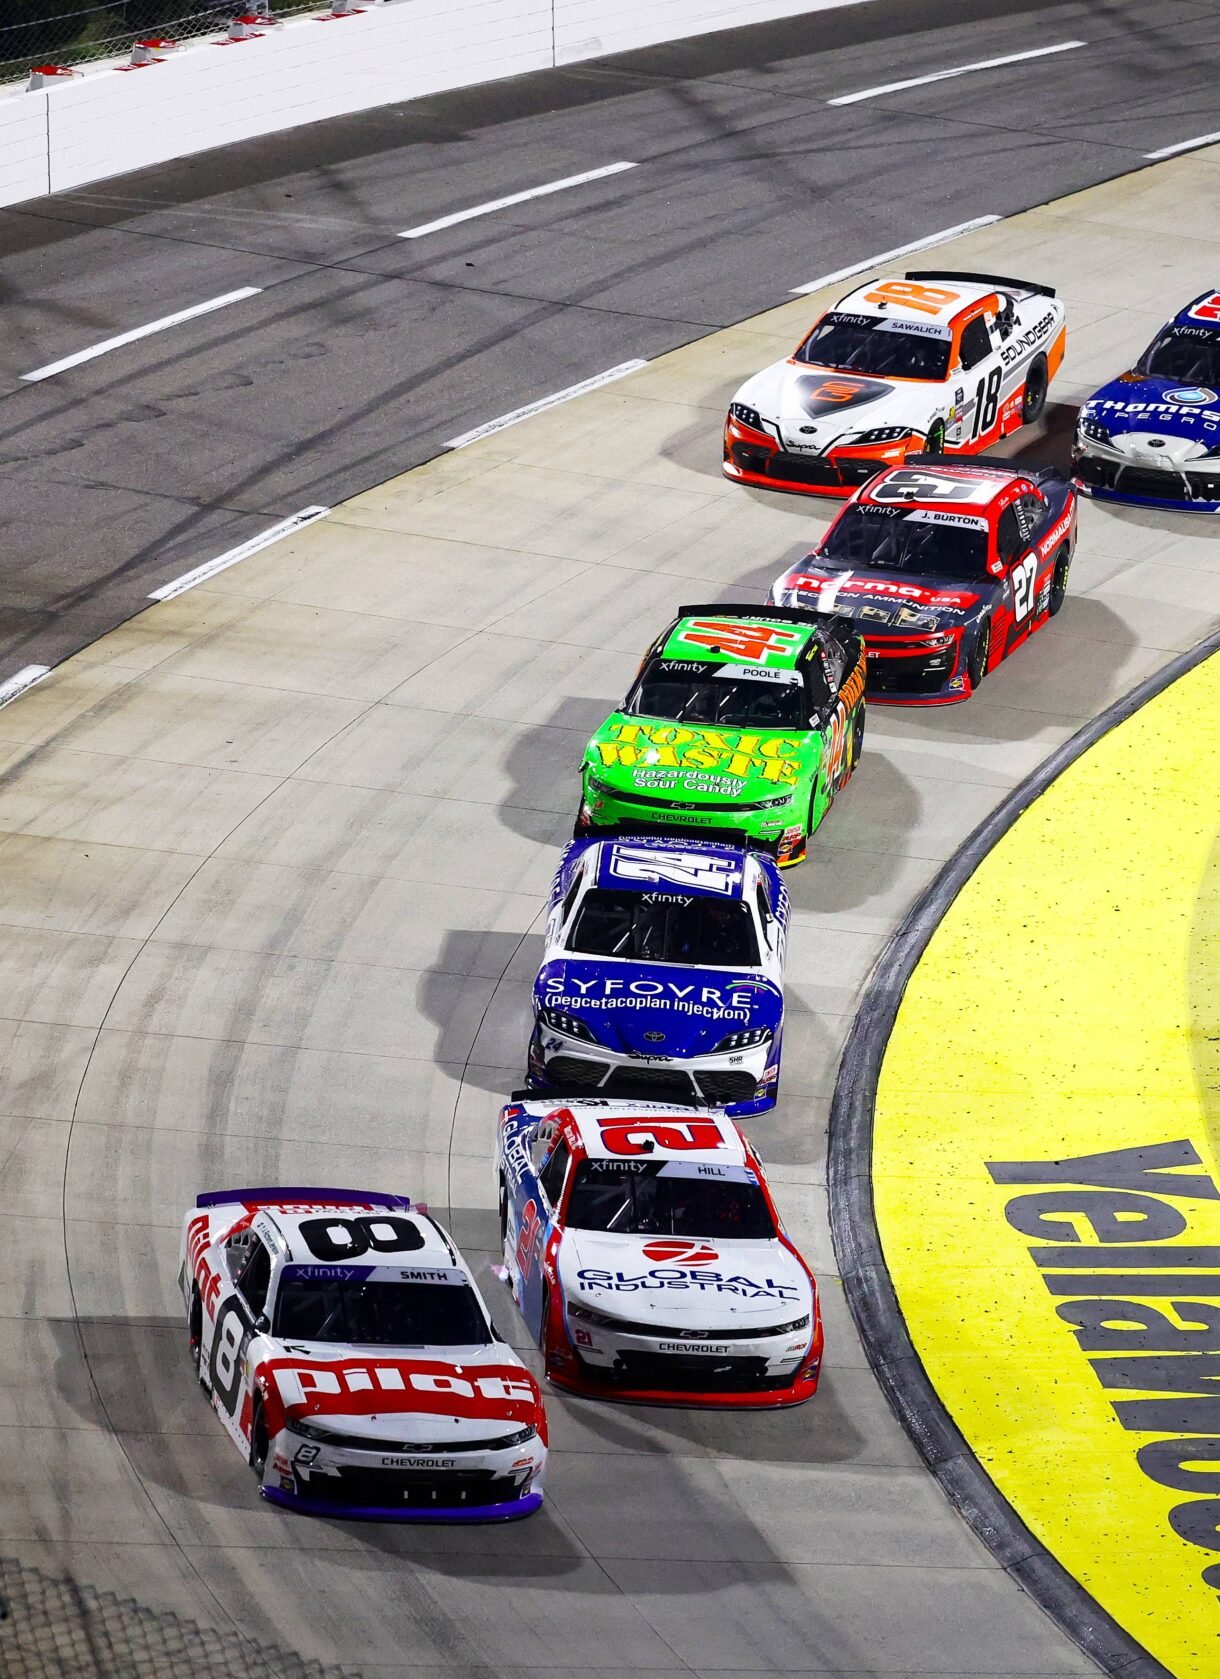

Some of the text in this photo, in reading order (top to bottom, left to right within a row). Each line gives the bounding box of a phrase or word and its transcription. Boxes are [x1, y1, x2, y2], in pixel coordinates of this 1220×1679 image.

[864, 282, 961, 315] 18
[830, 314, 871, 326] xfinity
[891, 322, 942, 335] SAWALICH
[1171, 326, 1212, 339] xfinity
[1000, 312, 1055, 366] SOUNDGEAR
[972, 366, 1002, 440] 18
[785, 439, 822, 451] Supra
[856, 504, 900, 517] xfinity
[934, 513, 979, 526] BURTON
[1012, 552, 1038, 622] 27
[862, 594, 966, 615] AMMUNITION
[930, 596, 961, 604] USA
[660, 661, 707, 673] xfinity
[743, 668, 781, 679] POOLE
[609, 724, 801, 758] TOXIC
[597, 743, 802, 786] WASTE
[632, 769, 747, 788] Hazardously
[634, 778, 741, 798] Sour Candy
[652, 812, 713, 825] CHEVROLET
[641, 892, 694, 906] xfinity
[546, 978, 751, 1008] SYFOVRE
[545, 994, 751, 1021] (pegcetacoplan injection)
[545, 1037, 563, 1051] 24
[627, 1052, 674, 1064] Supra
[503, 1120, 531, 1185] GLOBAL
[591, 1160, 648, 1173] xfinity
[698, 1166, 726, 1176] HILL
[298, 1216, 426, 1262] 8
[296, 1268, 354, 1280] xfinity
[401, 1271, 448, 1281] SMITH
[577, 1269, 798, 1291] GLOBAL
[579, 1281, 801, 1301] INDUSTRIAL
[576, 1329, 593, 1346] 21
[211, 1299, 246, 1408] 8
[659, 1343, 730, 1354] CHEVROLET
[272, 1367, 536, 1408] pilot
[295, 1444, 321, 1465] 8
[381, 1457, 456, 1468] CHEVROLET
